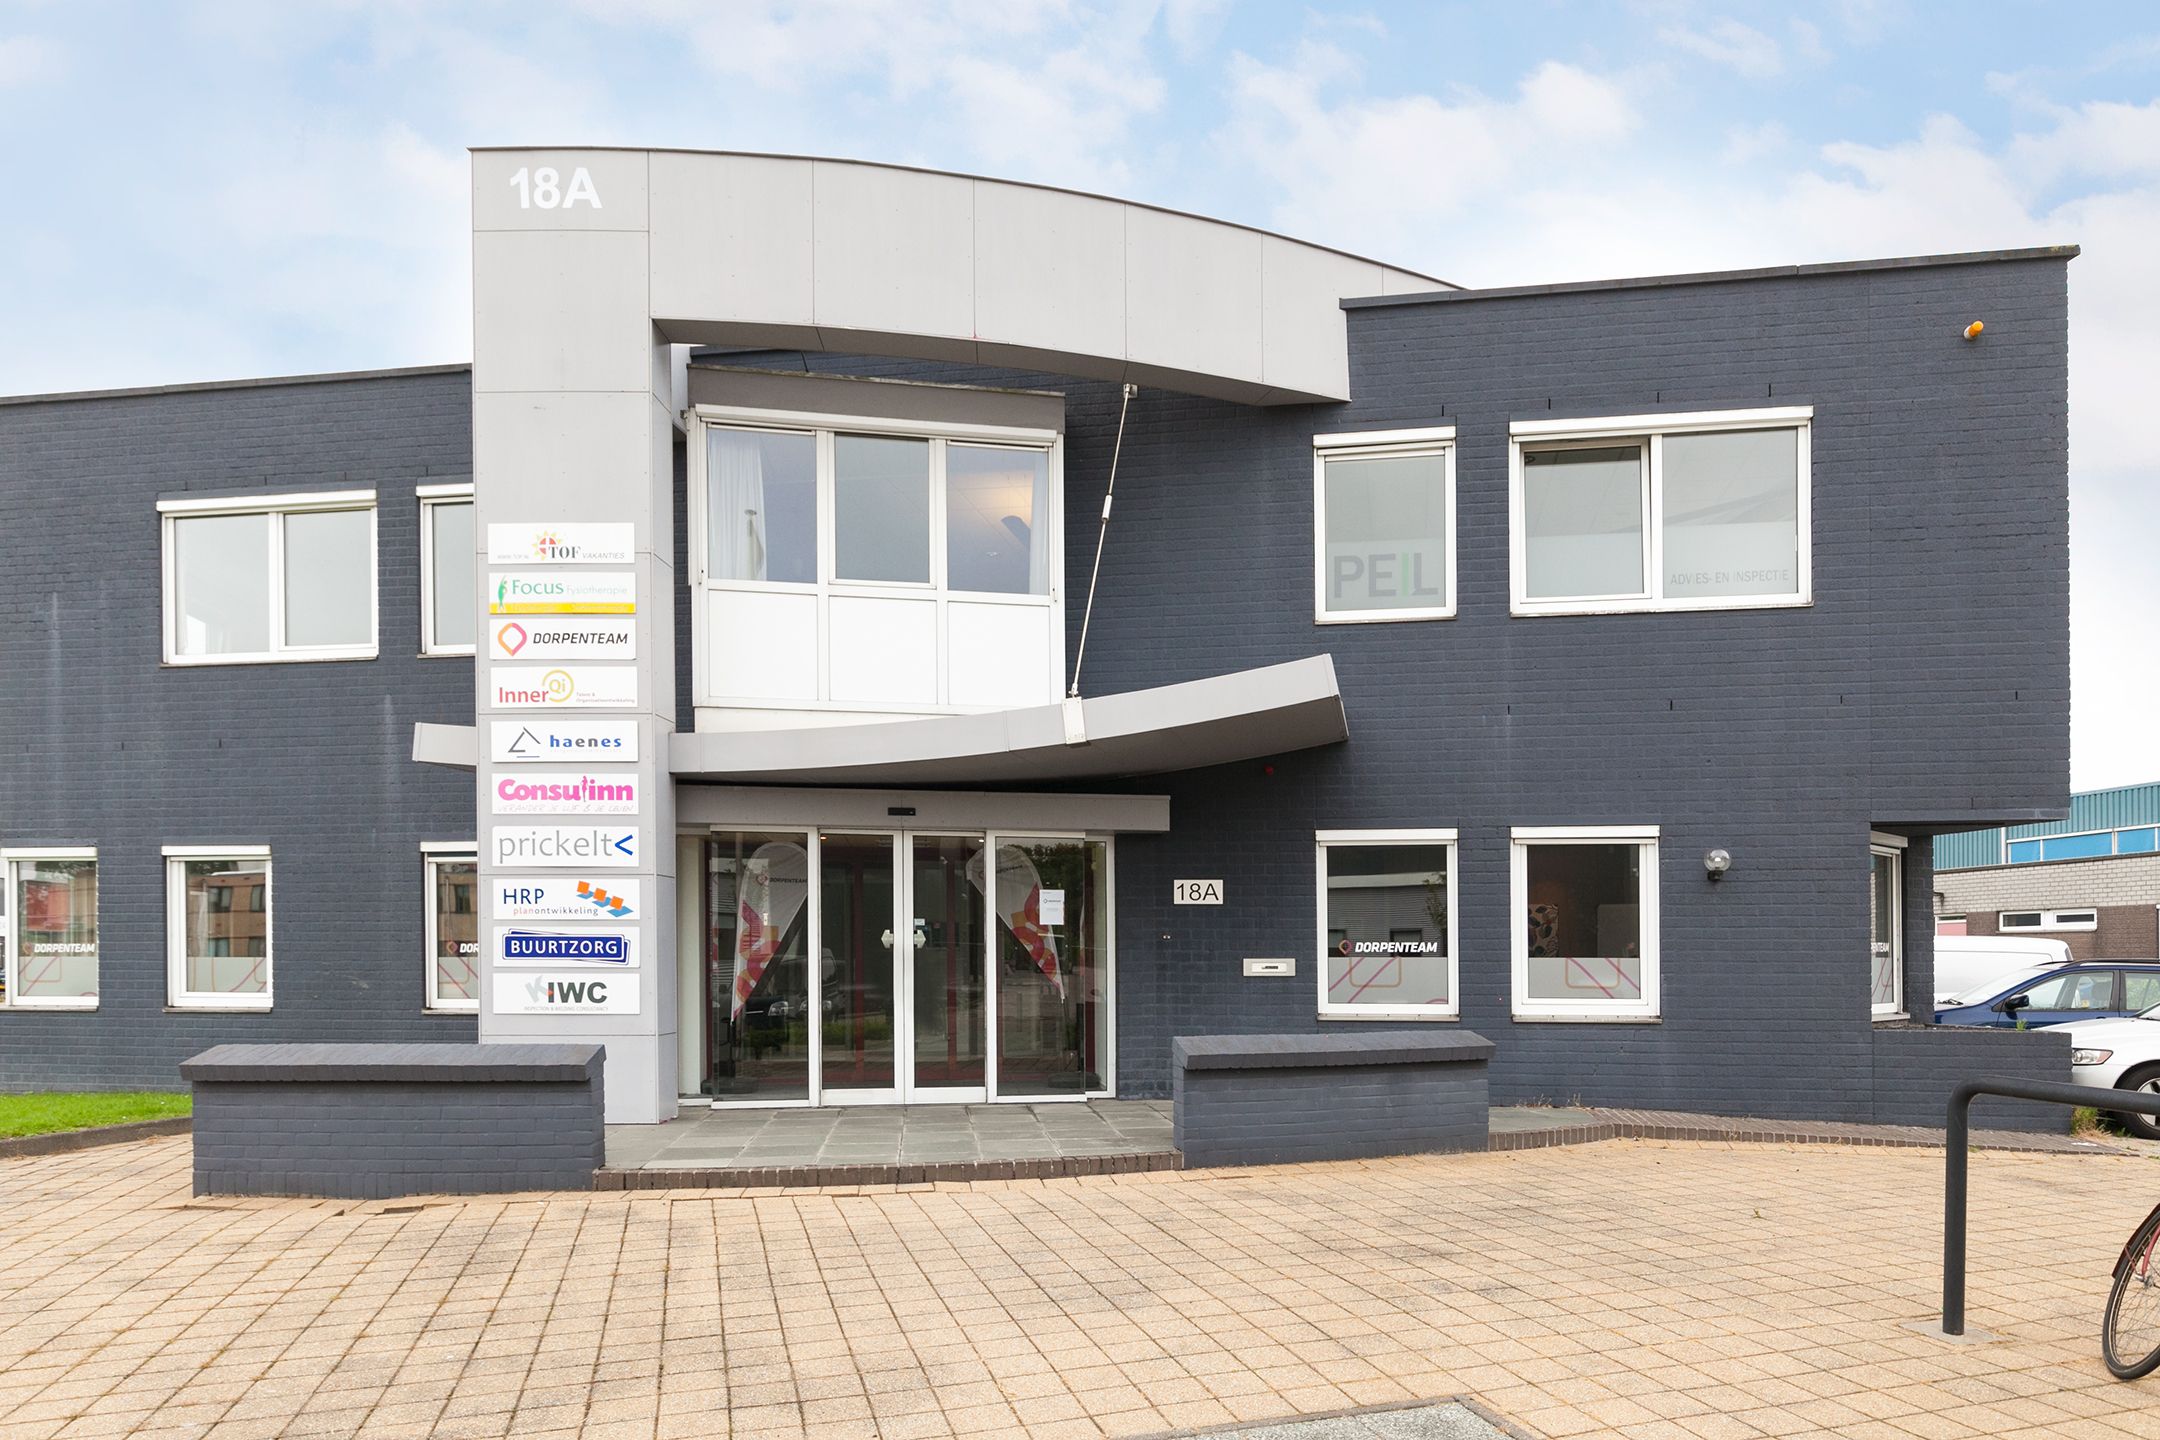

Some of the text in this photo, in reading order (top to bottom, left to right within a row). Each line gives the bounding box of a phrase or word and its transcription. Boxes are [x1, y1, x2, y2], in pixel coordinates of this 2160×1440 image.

[510, 167, 603, 210] 18A
[548, 546, 581, 559] TOF
[1333, 552, 1439, 599] PEIL
[1715, 571, 1729, 584] EN
[1733, 569, 1789, 583] INSPECTIE
[512, 579, 564, 595] Focus
[533, 632, 628, 644] DORPENTEAM
[498, 687, 549, 703] Inner
[549, 734, 622, 748] haenes
[499, 830, 613, 864] prickelt
[503, 888, 545, 905] HRP
[1176, 882, 1219, 901] 18A
[513, 906, 599, 916] planontwikkeling
[34, 943, 95, 953] DORPENTEAM
[511, 940, 618, 954] BUURTZORG
[1355, 942, 1438, 953] DORPENTEAM
